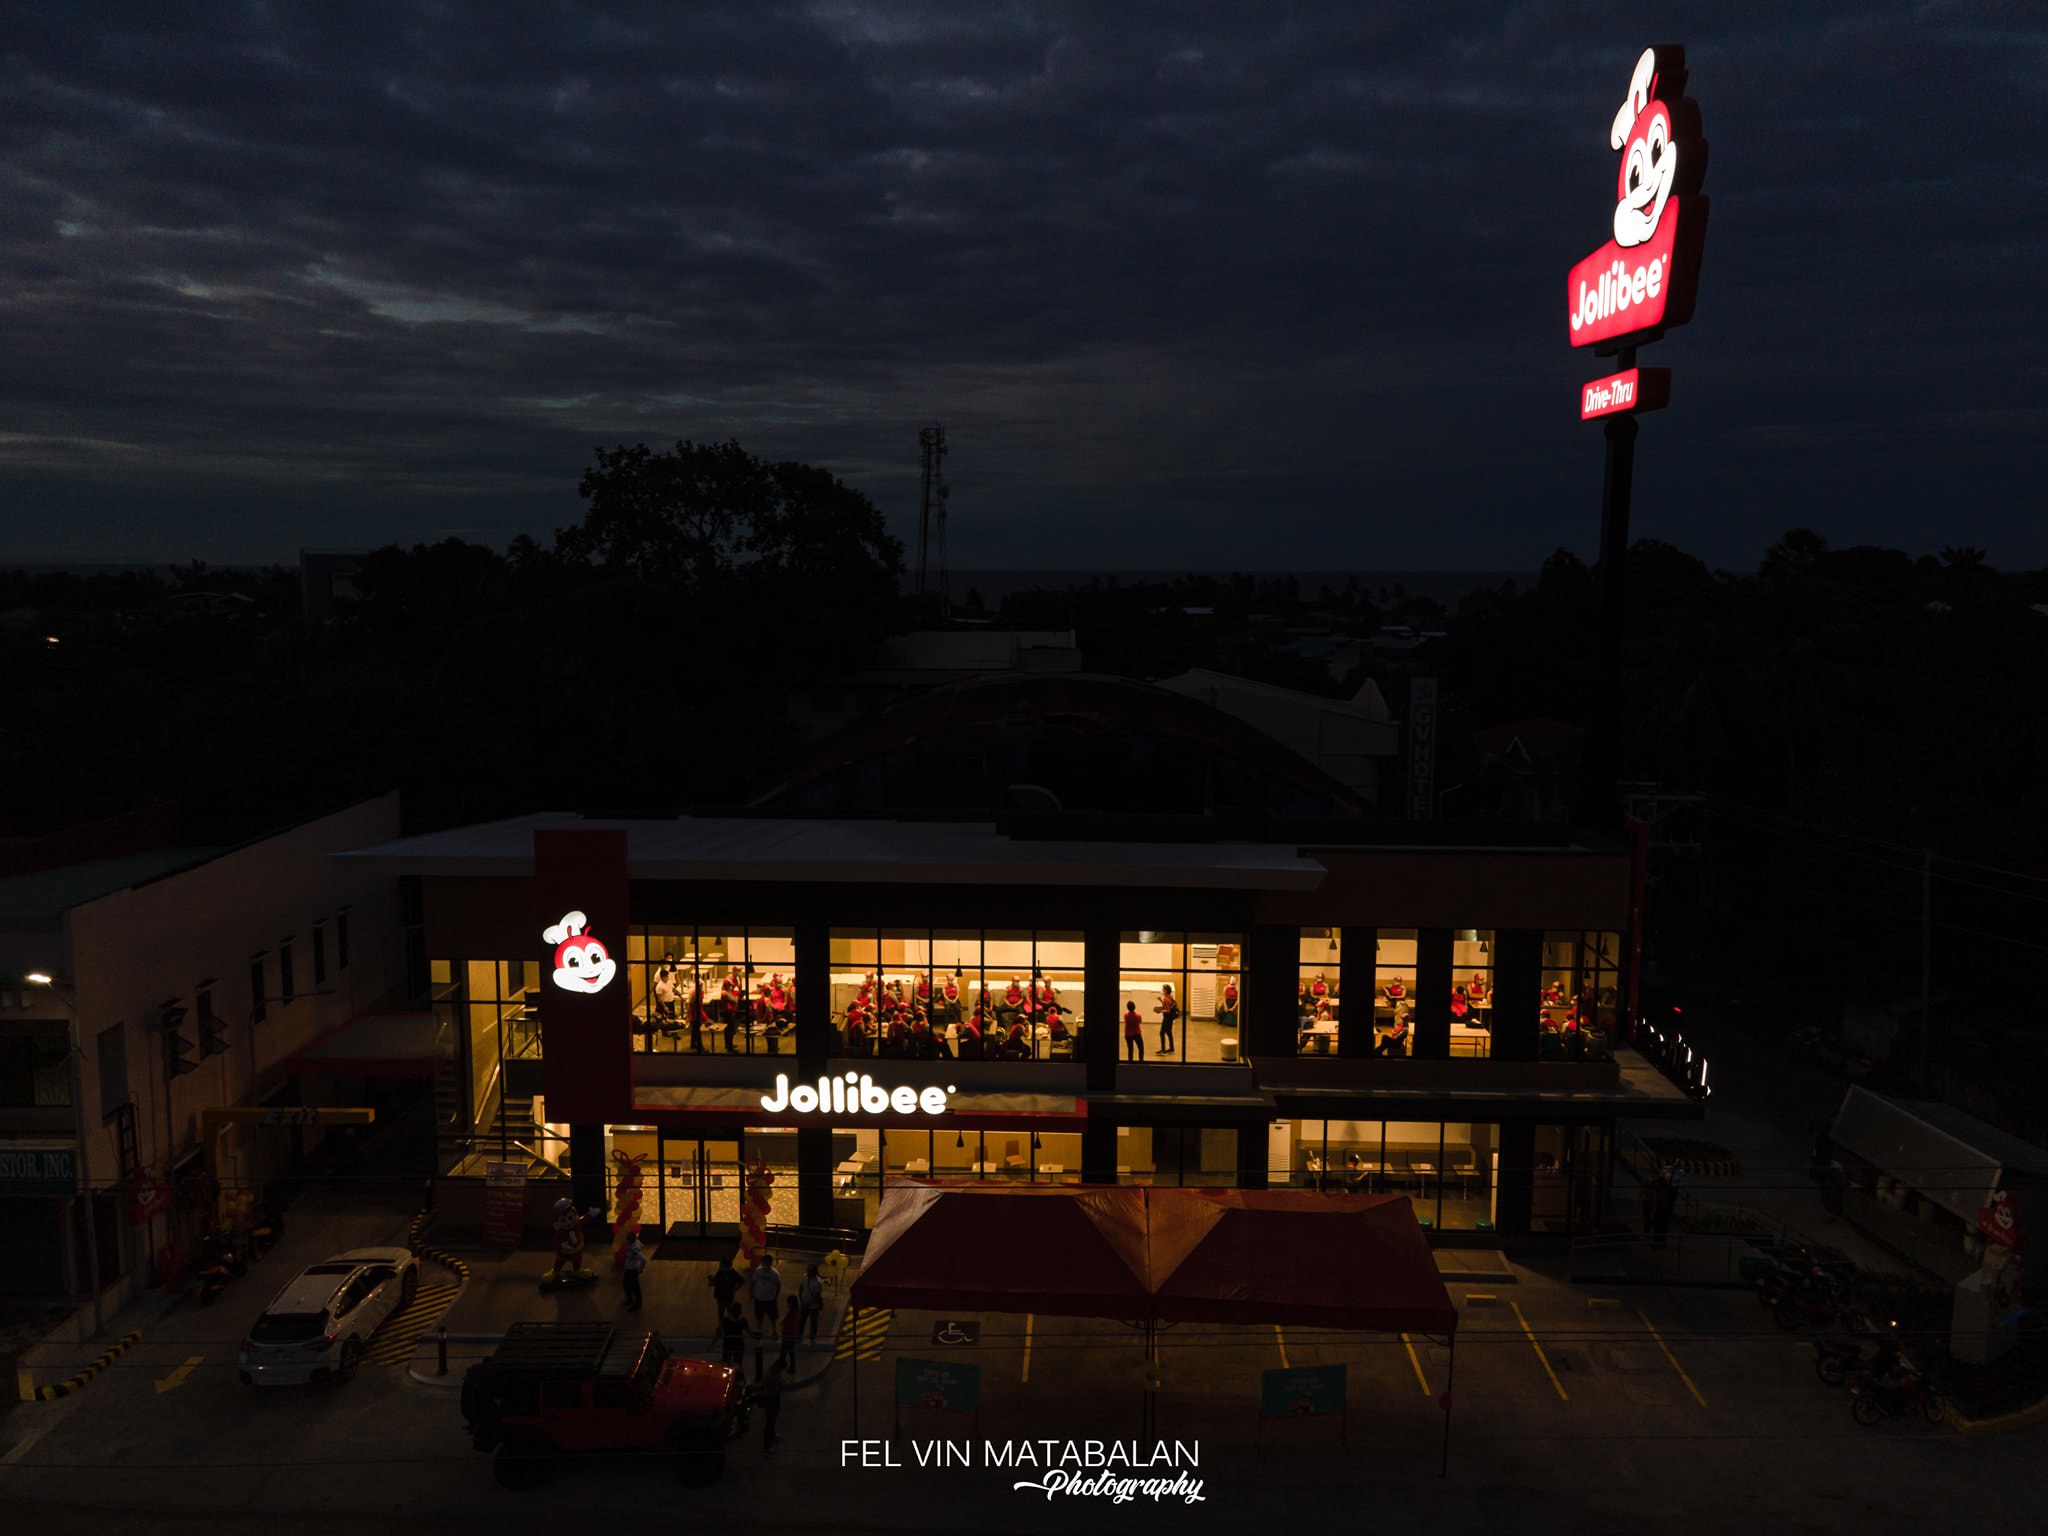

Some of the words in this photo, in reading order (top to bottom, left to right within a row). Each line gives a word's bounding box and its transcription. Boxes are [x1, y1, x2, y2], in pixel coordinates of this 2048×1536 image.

[1571, 257, 1664, 331] Jollibee
[1584, 379, 1634, 413] Drive-Thru
[760, 1071, 948, 1115] Jollibee
